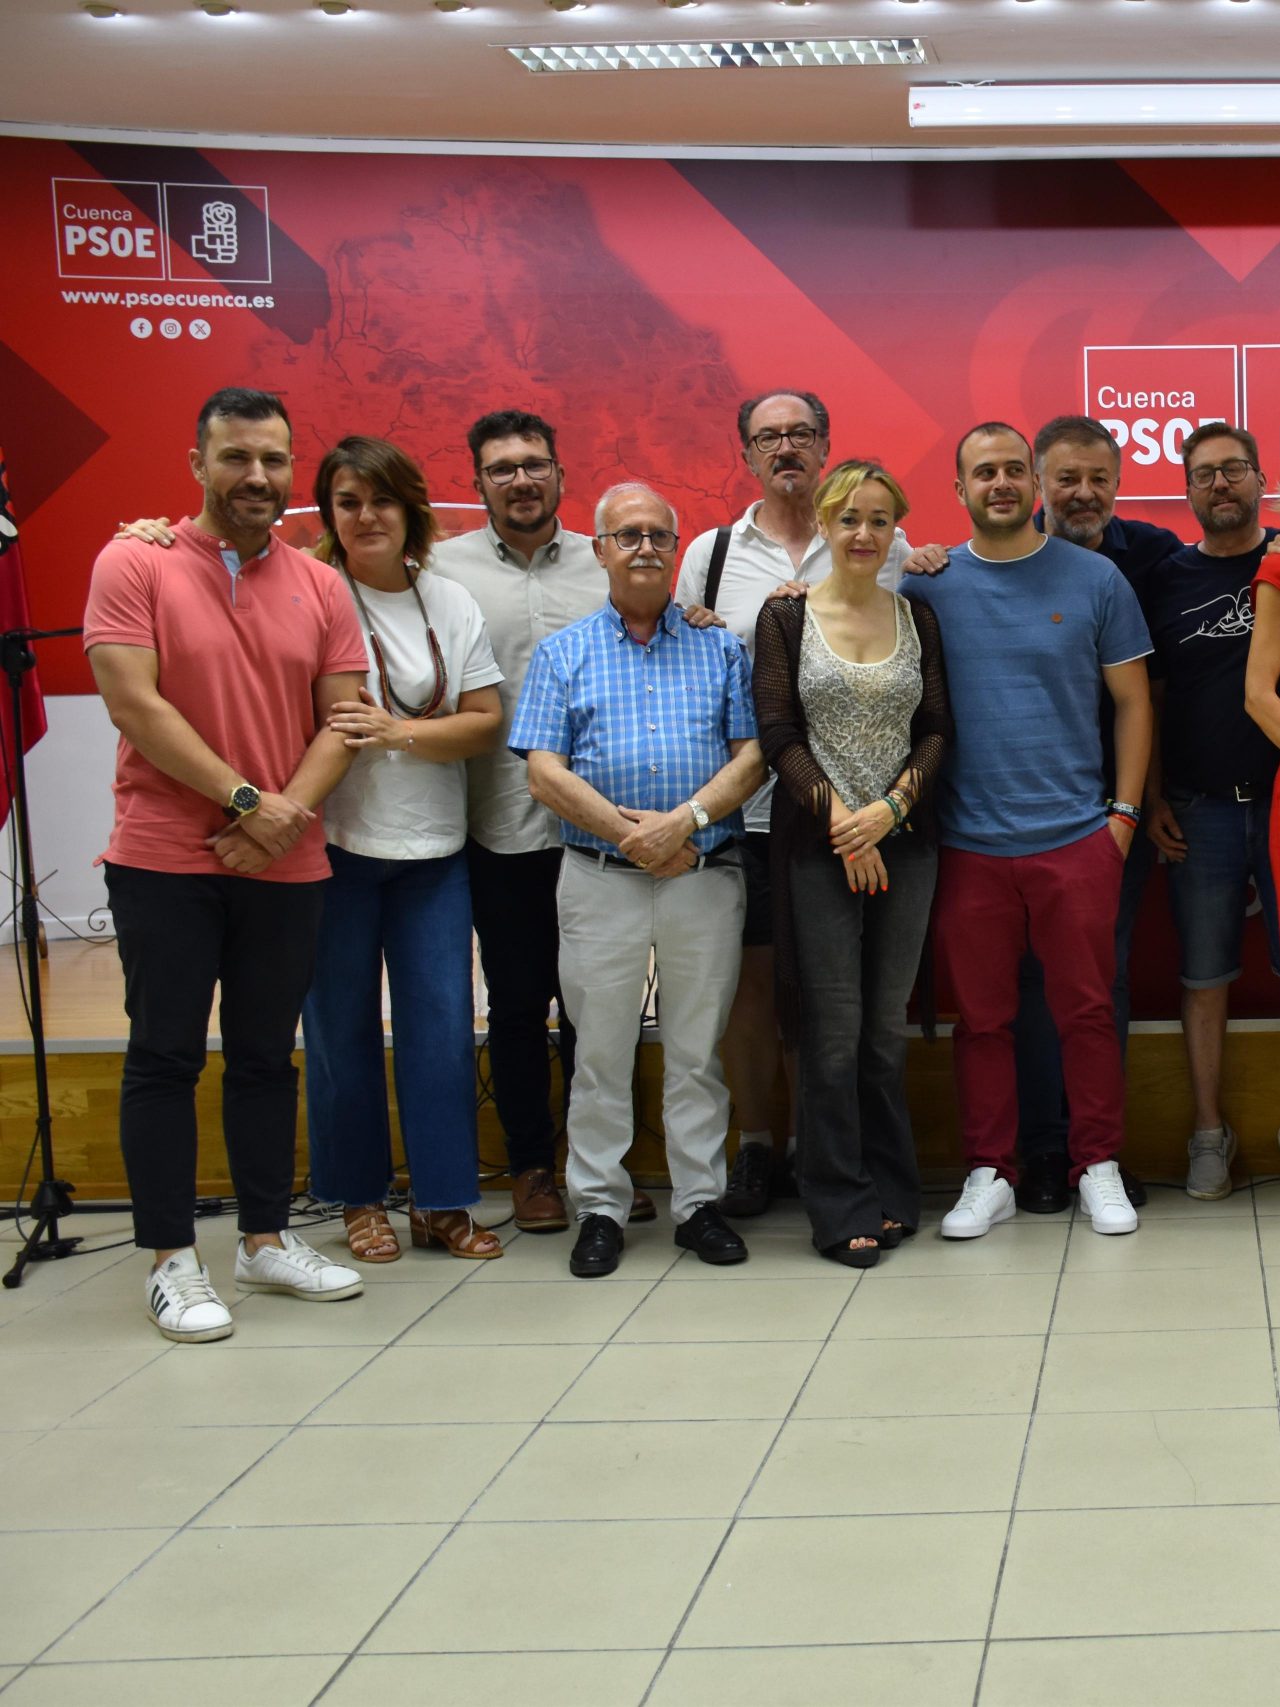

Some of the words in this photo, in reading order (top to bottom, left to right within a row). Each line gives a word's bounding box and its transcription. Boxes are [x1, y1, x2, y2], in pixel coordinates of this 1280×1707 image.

[63, 203, 133, 222] Cuenca
[65, 225, 156, 258] PSOE
[61, 290, 275, 309] www.psoecuenca.es
[1097, 385, 1196, 408] Cuenca
[1098, 417, 1226, 466] PSO
